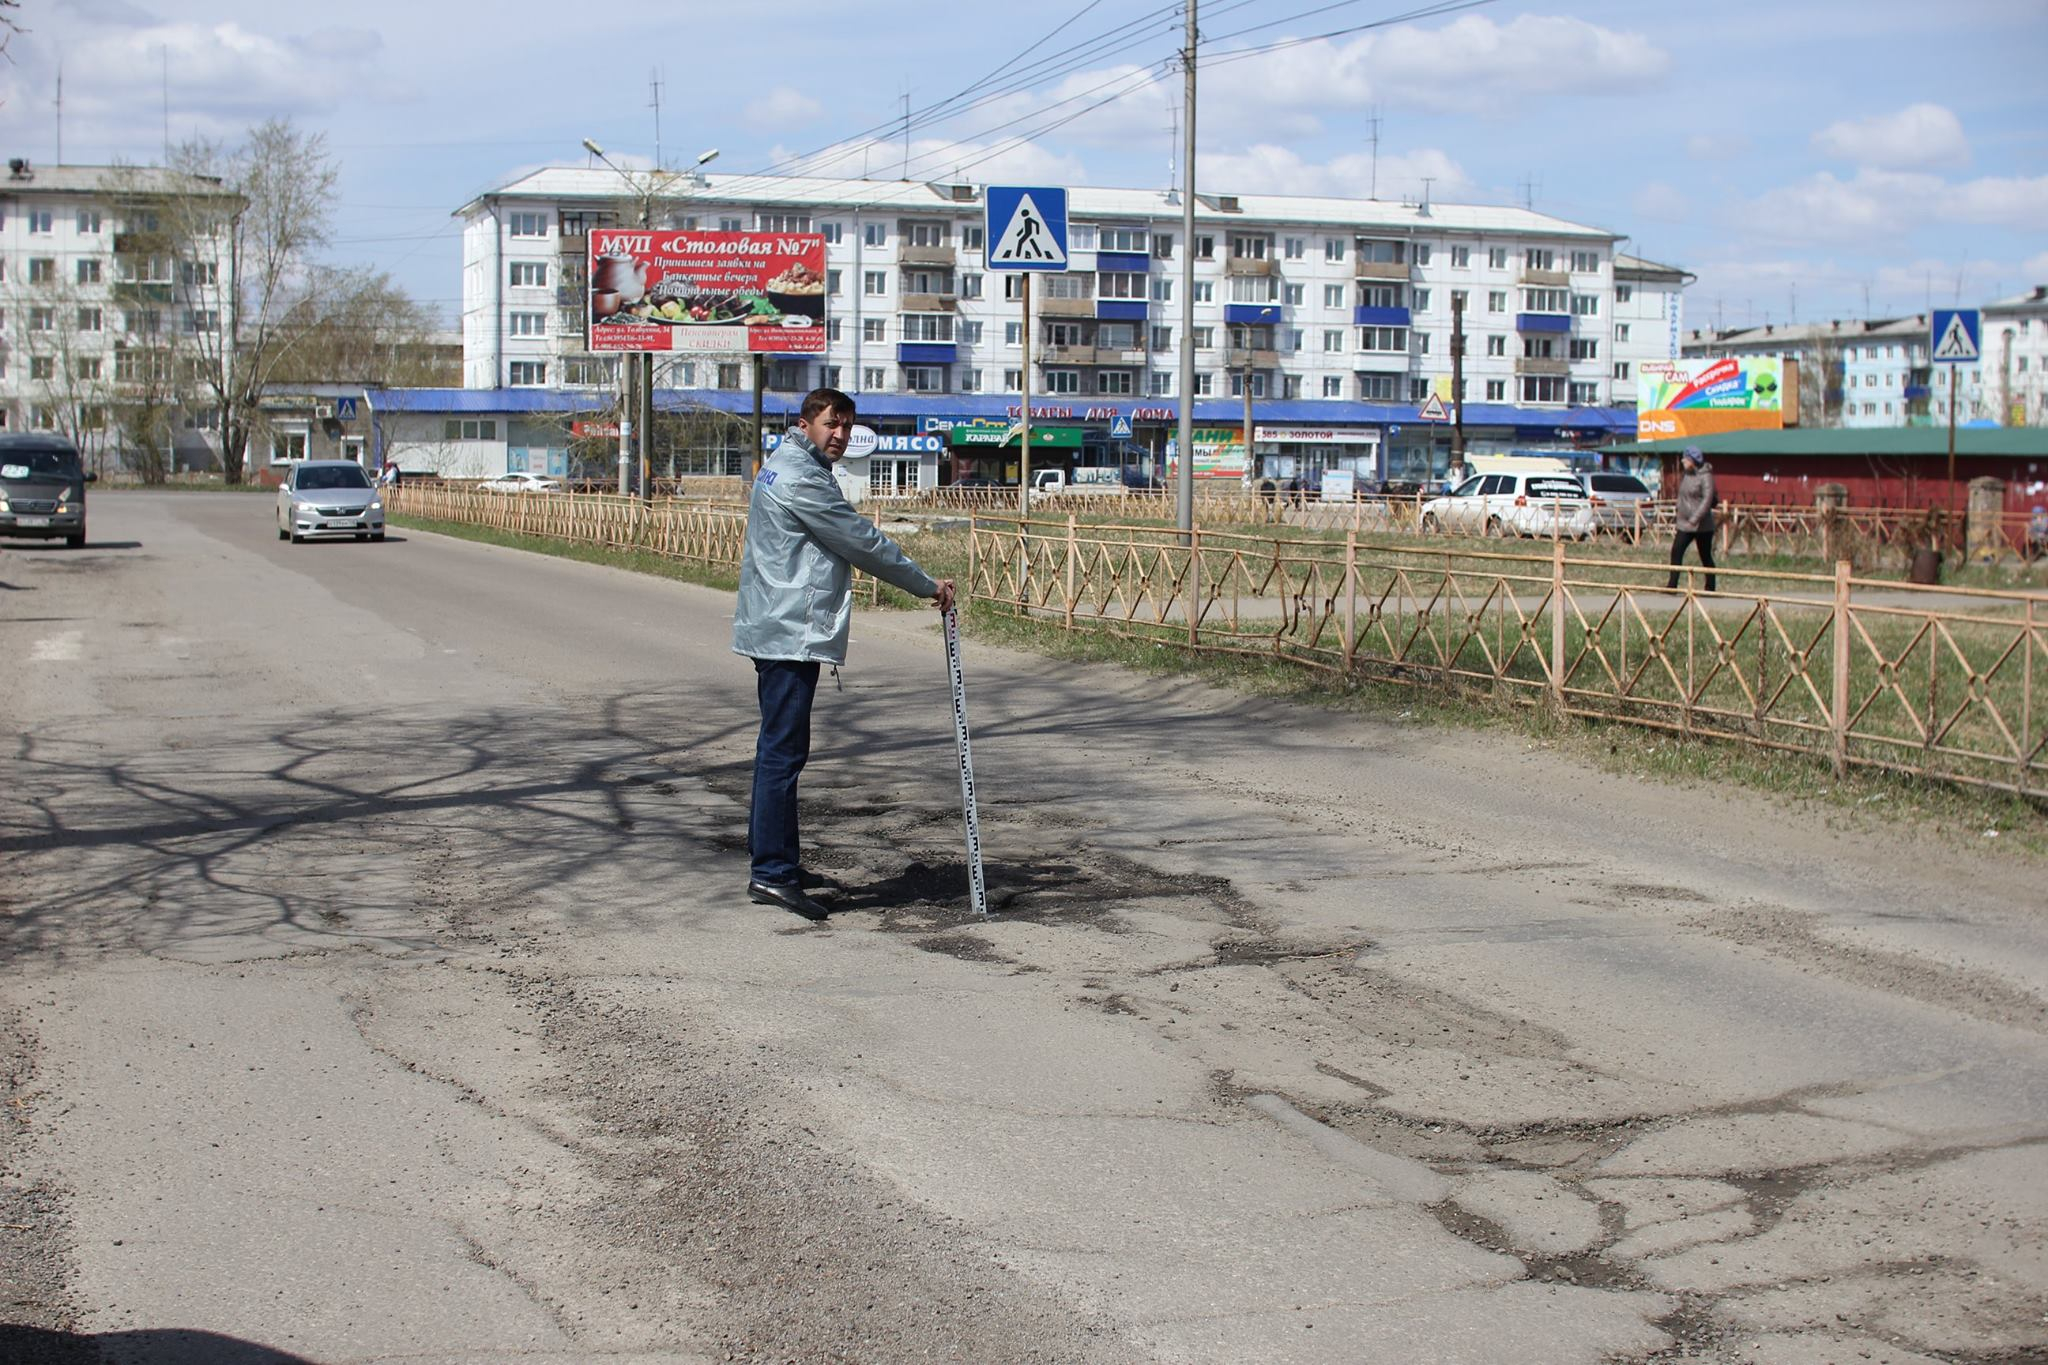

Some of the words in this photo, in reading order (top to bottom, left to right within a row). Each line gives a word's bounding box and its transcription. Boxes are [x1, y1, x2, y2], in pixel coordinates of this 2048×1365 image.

[599, 236, 652, 254] МУП
[661, 237, 772, 255] «Столовая
[654, 256, 714, 269] Принимаем
[716, 257, 751, 269] заявки
[753, 260, 766, 269] на
[662, 271, 722, 283] Банкетные
[724, 272, 758, 285] вечера
[733, 284, 765, 297] обеды
[1639, 420, 1676, 433] DNS
[1169, 429, 1234, 443] ТАНИ
[1289, 430, 1334, 439] ЗОЛОТОЙ
[878, 435, 941, 451] МЯСО
